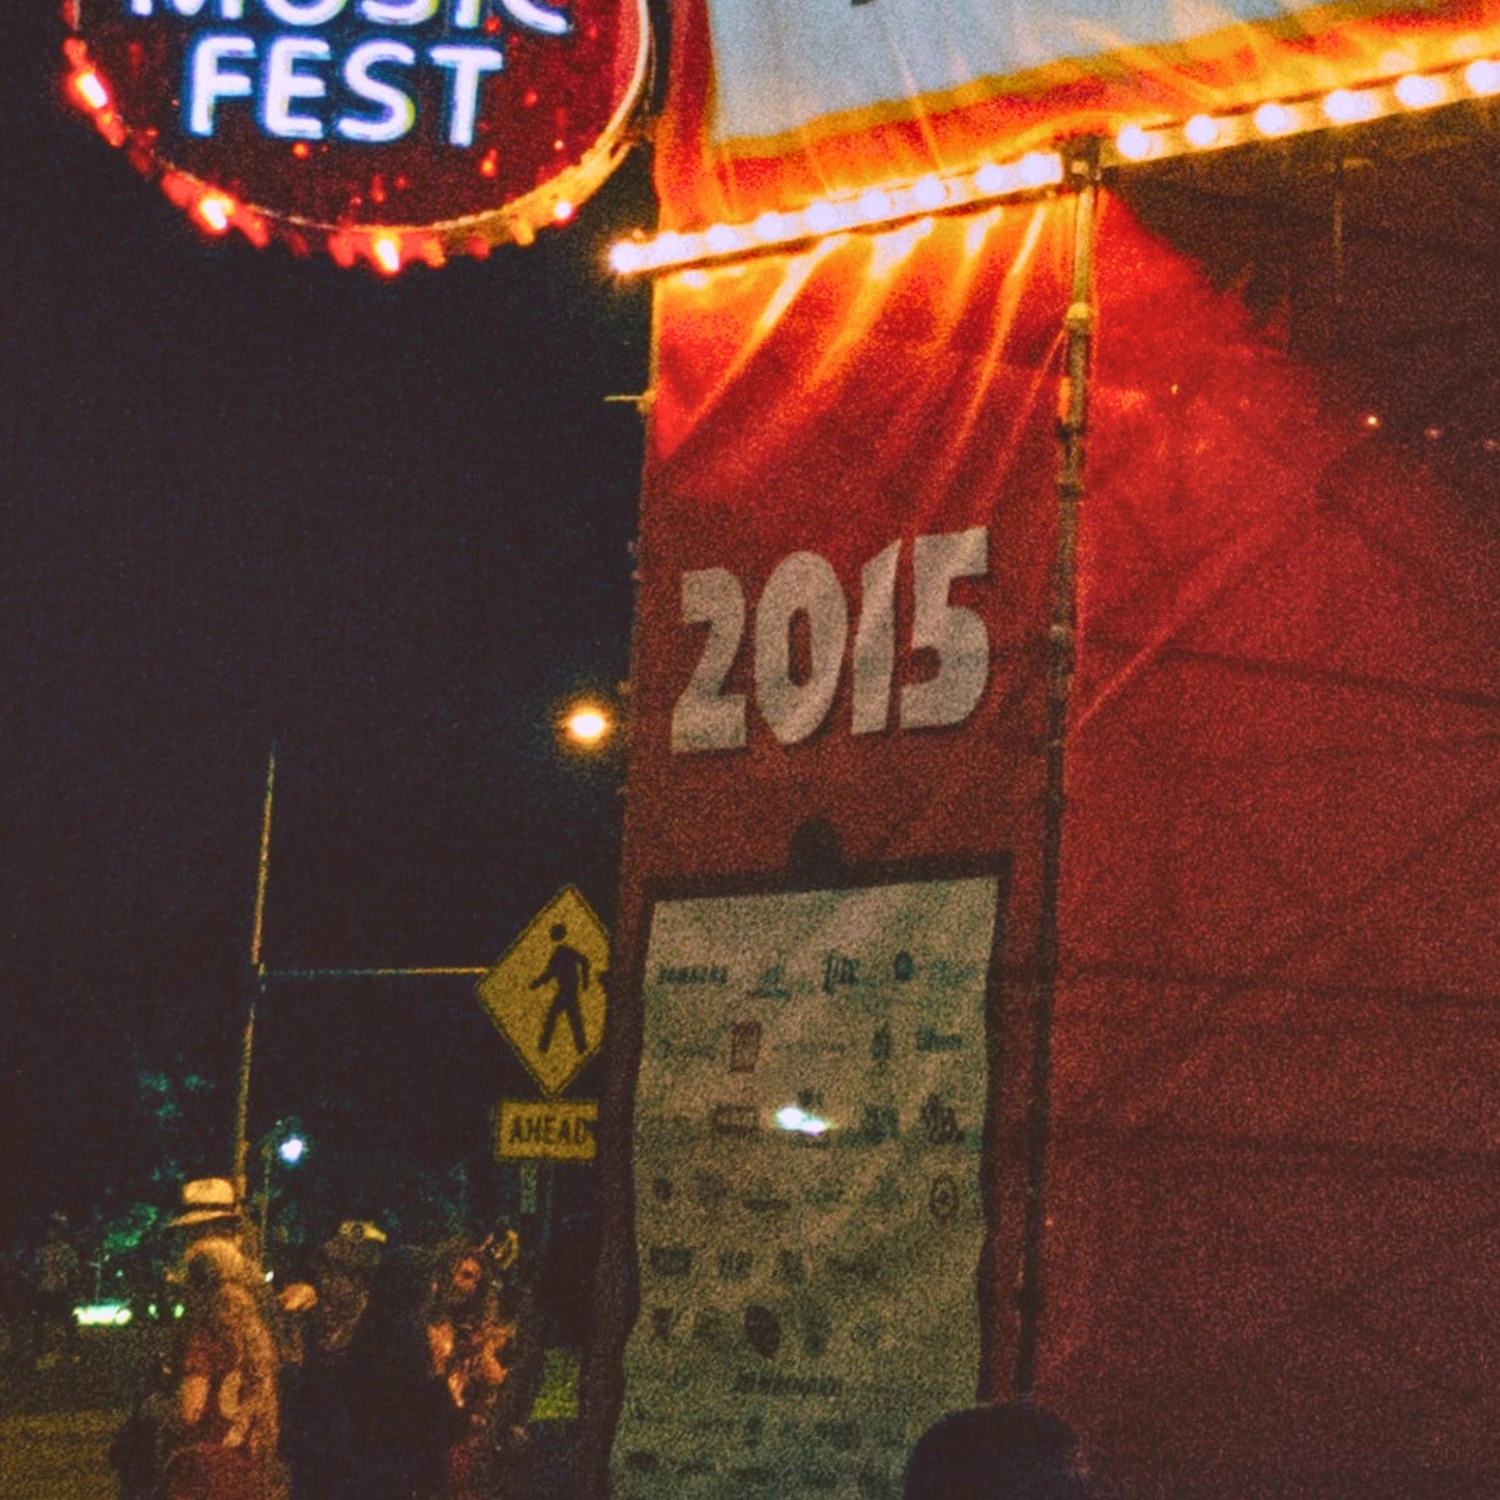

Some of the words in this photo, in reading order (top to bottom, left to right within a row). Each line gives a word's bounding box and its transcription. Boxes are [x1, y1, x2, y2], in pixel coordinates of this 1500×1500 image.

[187, 34, 504, 148] FEST
[671, 526, 990, 755] 2015
[507, 1114, 589, 1145] AHEAD
